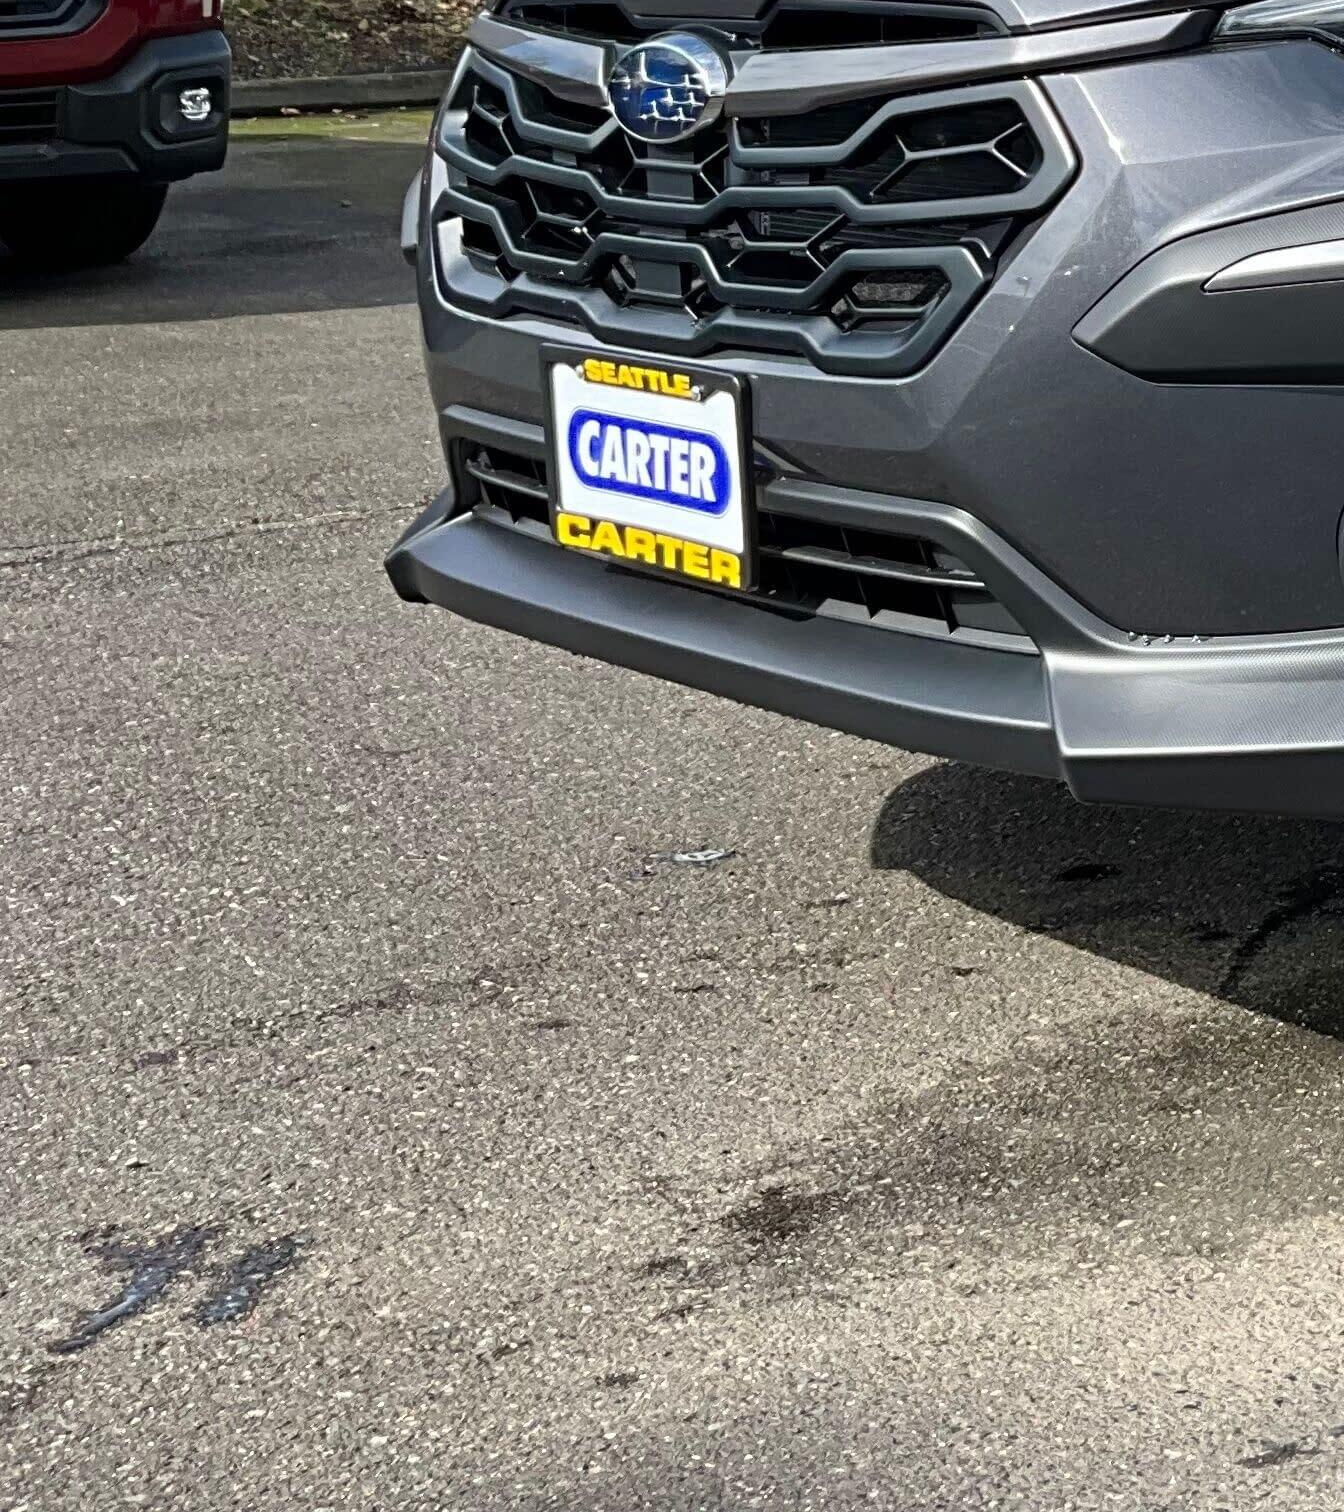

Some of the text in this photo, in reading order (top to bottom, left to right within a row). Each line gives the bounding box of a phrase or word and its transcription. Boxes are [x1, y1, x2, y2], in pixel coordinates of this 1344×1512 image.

[583, 358, 693, 399] SEATTLE
[577, 419, 717, 503] CARTER
[556, 511, 742, 589] CARTER
